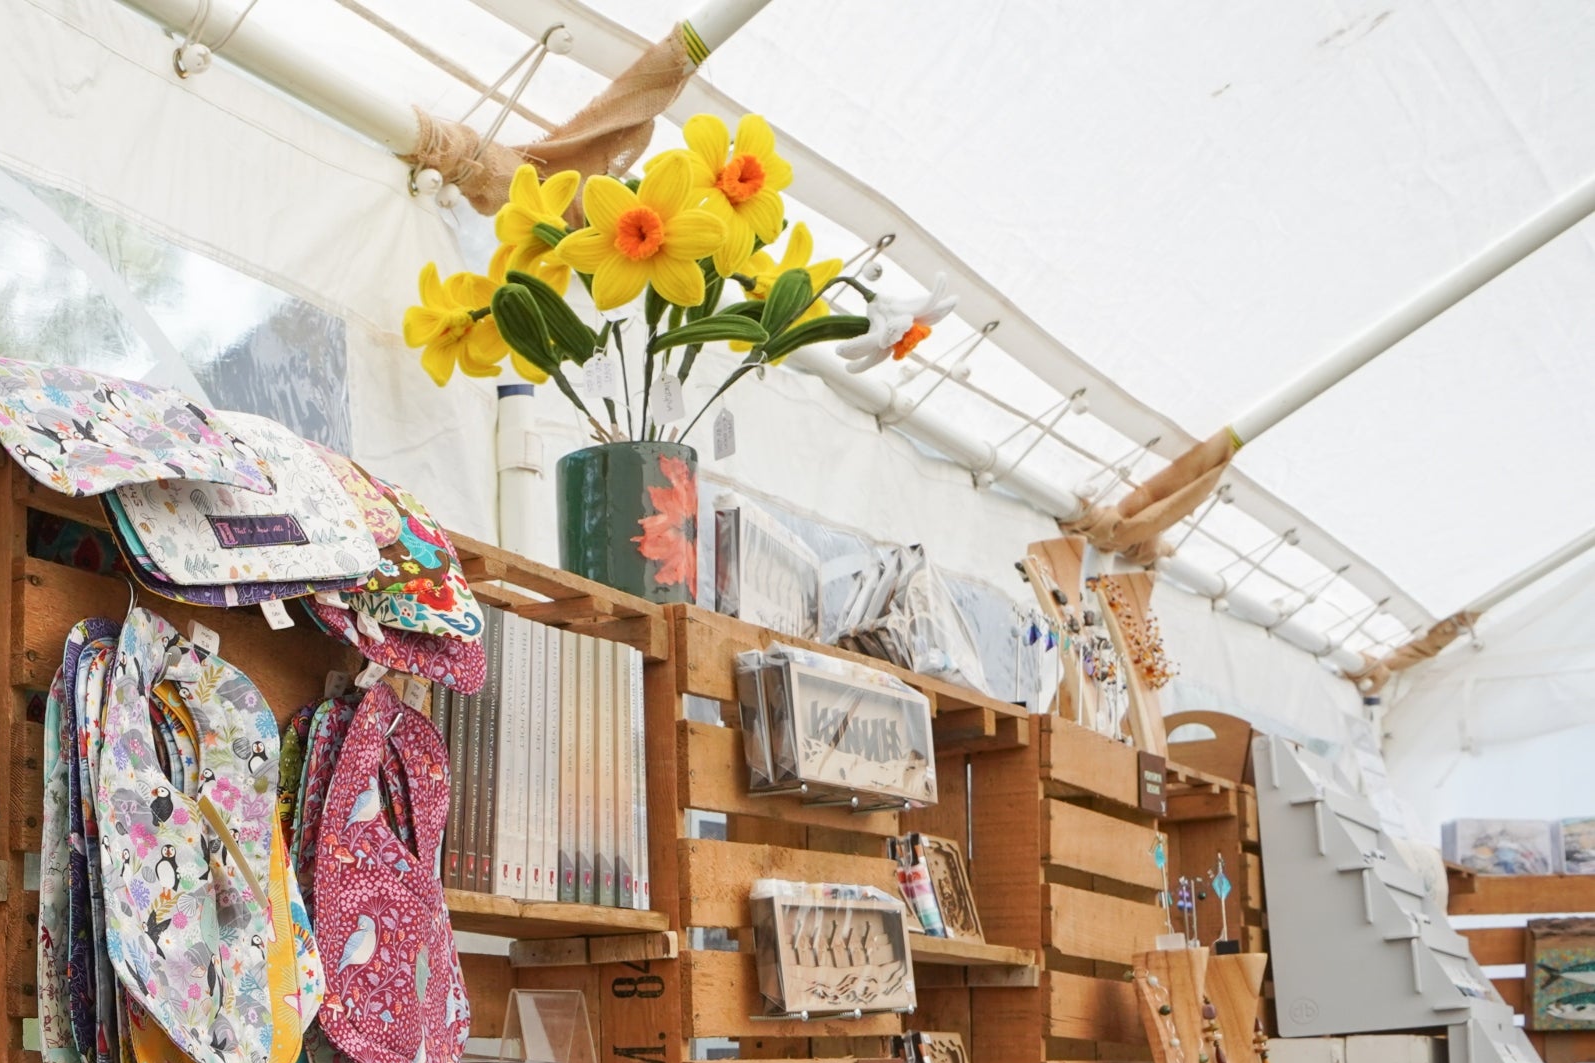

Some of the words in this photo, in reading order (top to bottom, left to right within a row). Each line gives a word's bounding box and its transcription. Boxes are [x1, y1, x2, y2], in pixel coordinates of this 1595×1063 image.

[475, 694, 483, 716] MISS
[457, 714, 466, 740] LUCY
[474, 717, 482, 743] LUCY
[456, 741, 464, 773] JONES
[473, 744, 481, 776] JONES
